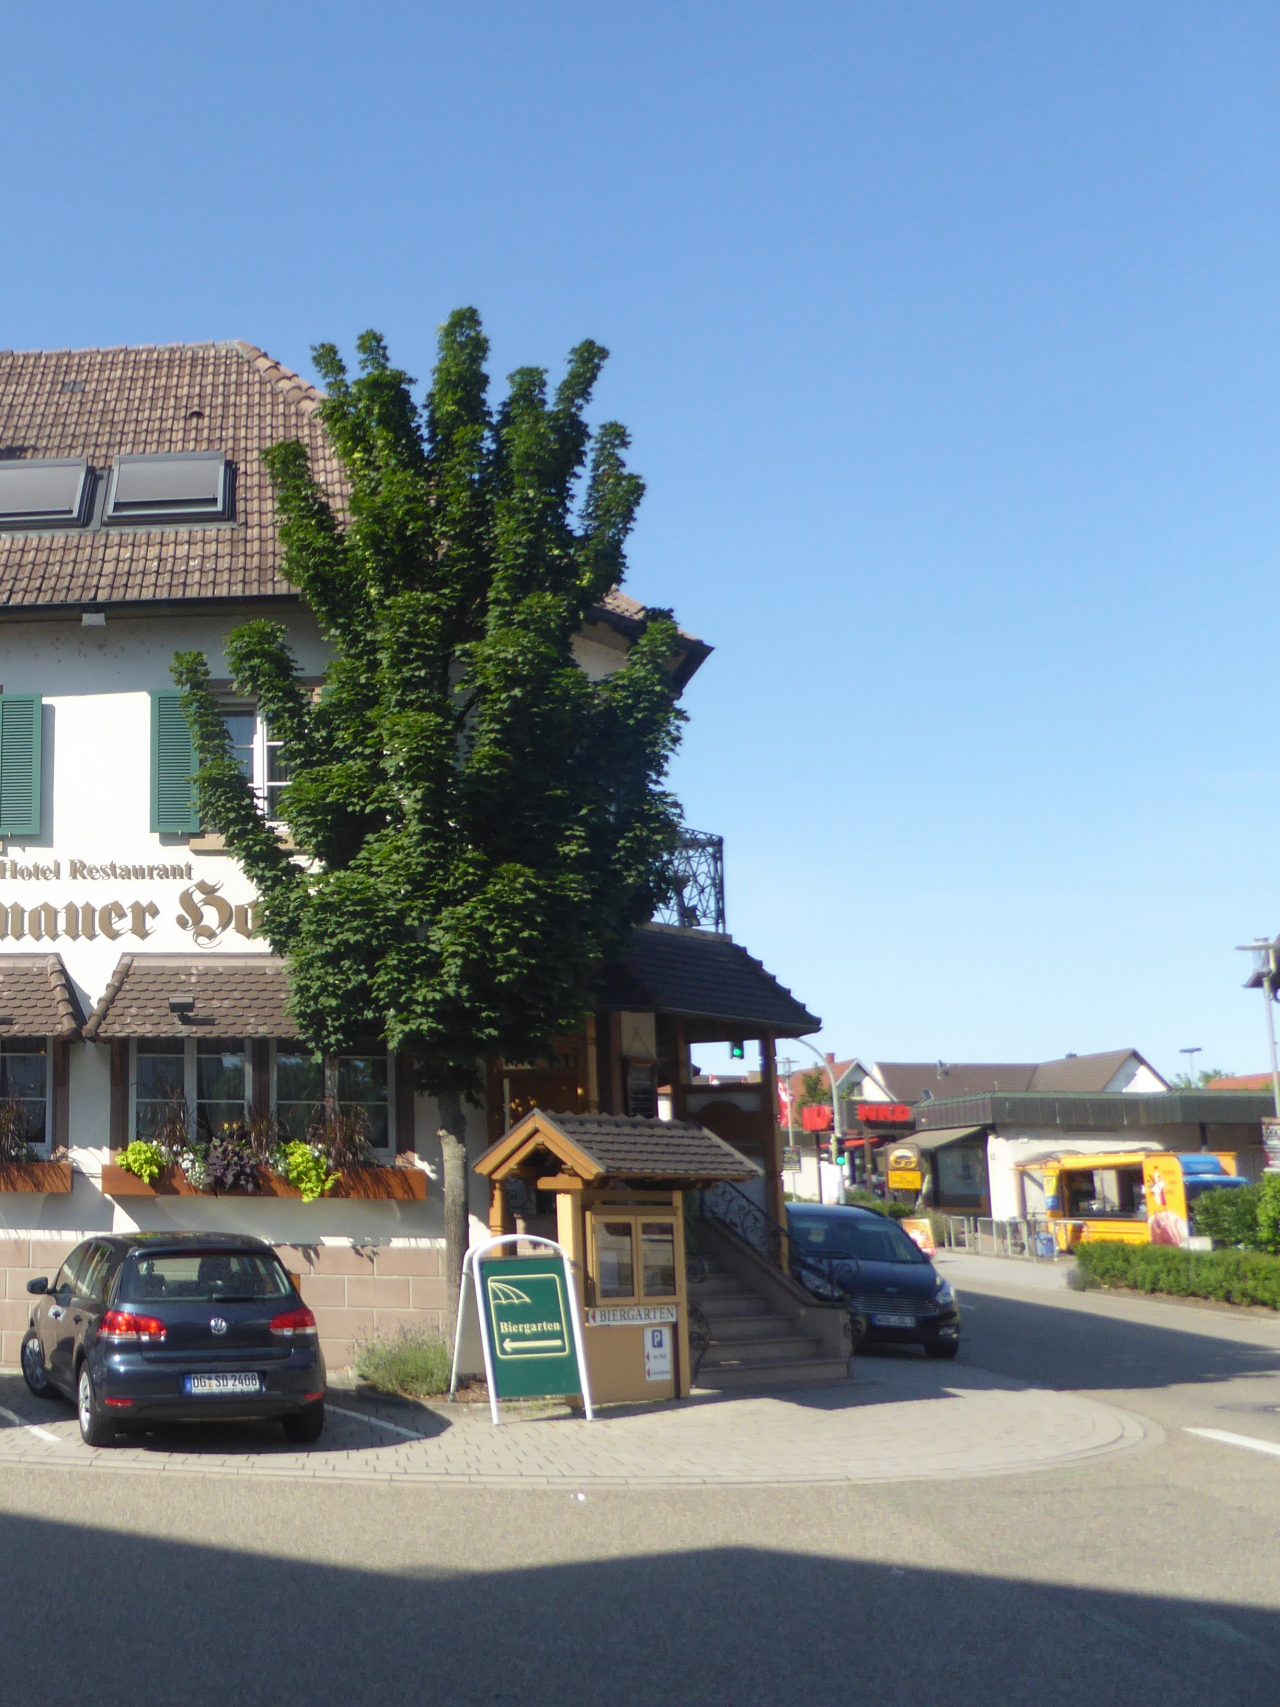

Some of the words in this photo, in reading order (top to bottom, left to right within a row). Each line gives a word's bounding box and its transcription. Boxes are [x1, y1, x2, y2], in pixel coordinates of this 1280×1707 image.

[68, 858, 194, 881] Restaurant
[175, 879, 267, 949] Ho
[599, 1306, 675, 1322] BIERGARTEN
[499, 1321, 561, 1334] Biergarten
[653, 1331, 661, 1346] P
[192, 1375, 207, 1388] OG
